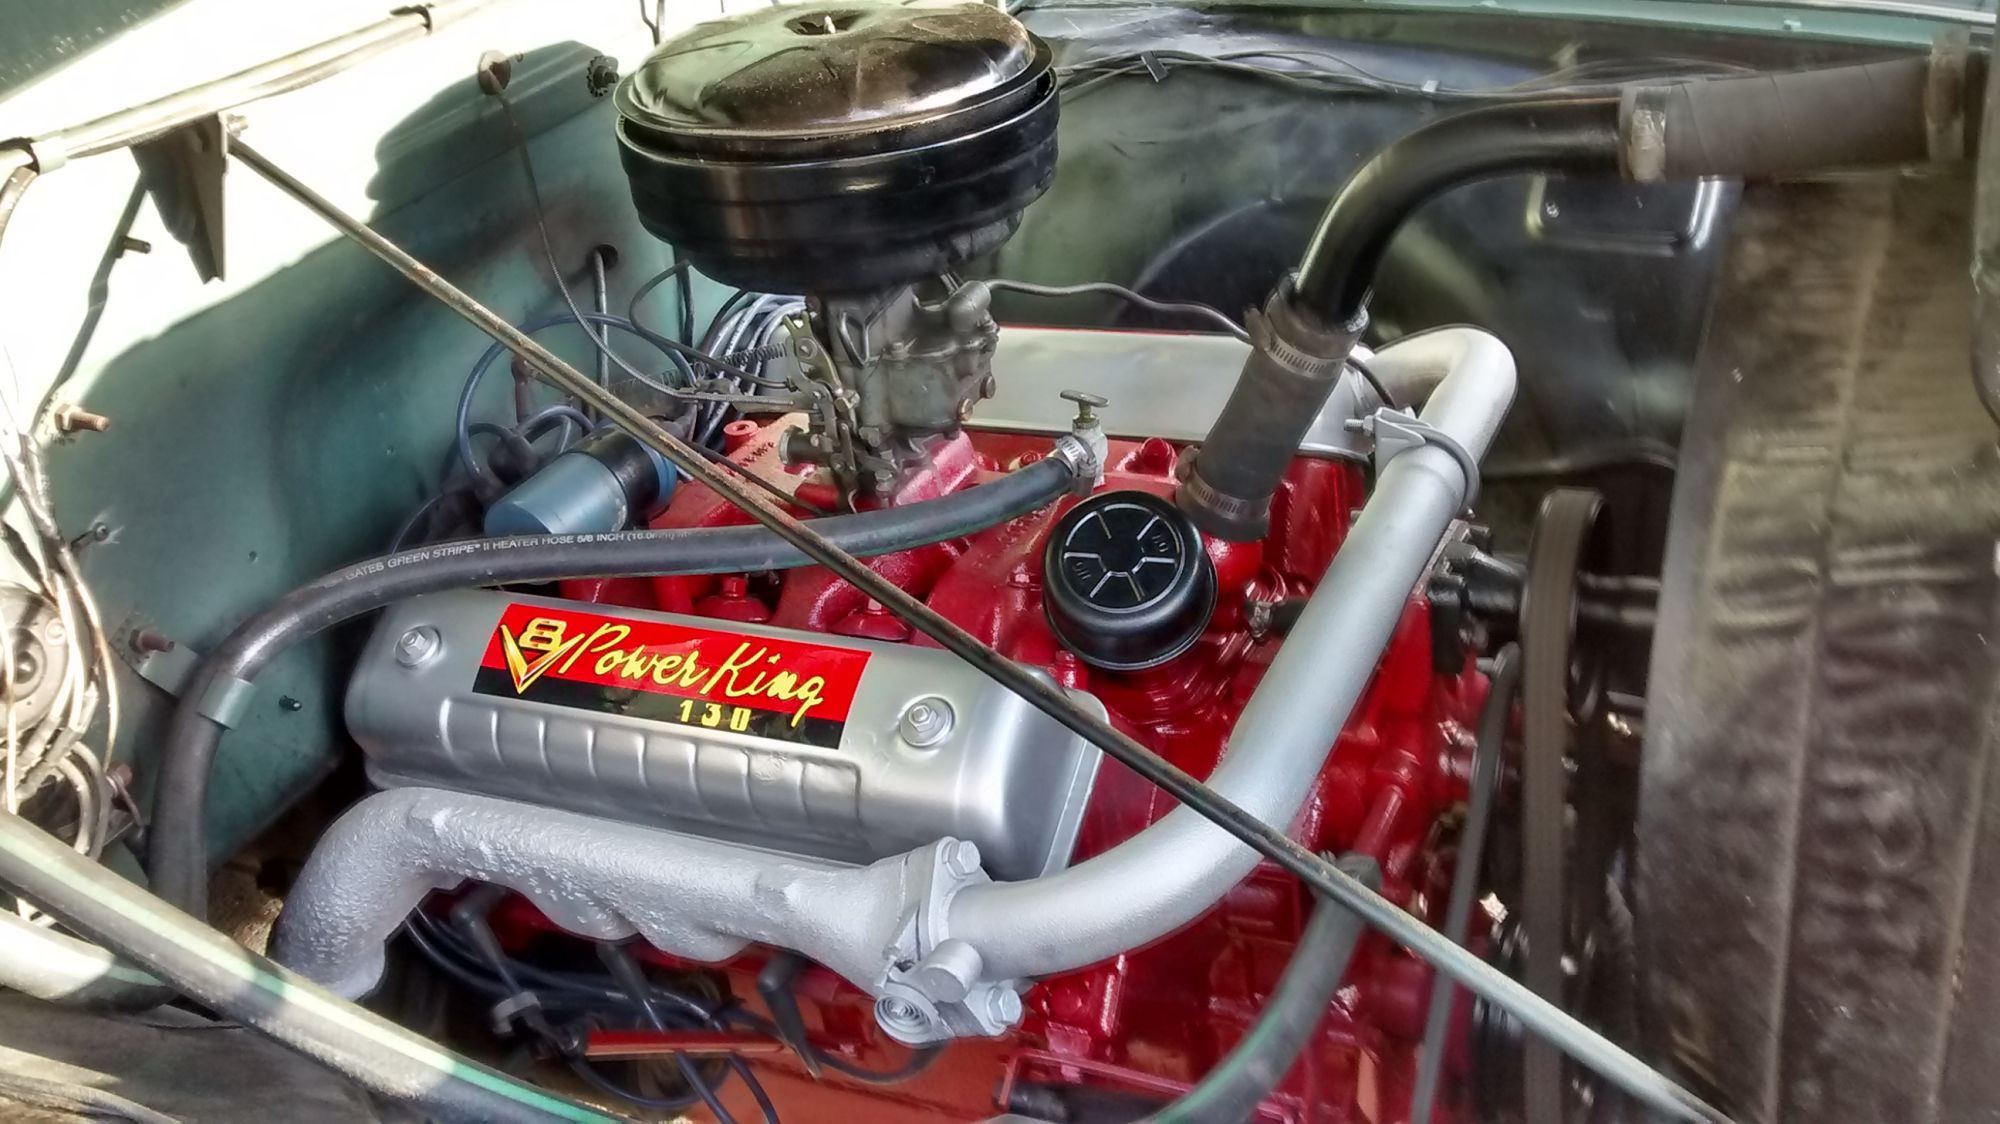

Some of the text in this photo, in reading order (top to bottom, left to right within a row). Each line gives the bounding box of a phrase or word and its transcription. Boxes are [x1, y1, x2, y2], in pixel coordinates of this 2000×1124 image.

[388, 552, 430, 568] GREEN
[492, 538, 538, 550] HEATER
[542, 535, 573, 545] HOSE
[596, 533, 624, 542] INCH
[558, 621, 708, 688] Power
[699, 642, 824, 728] King
[678, 699, 752, 732] 130
